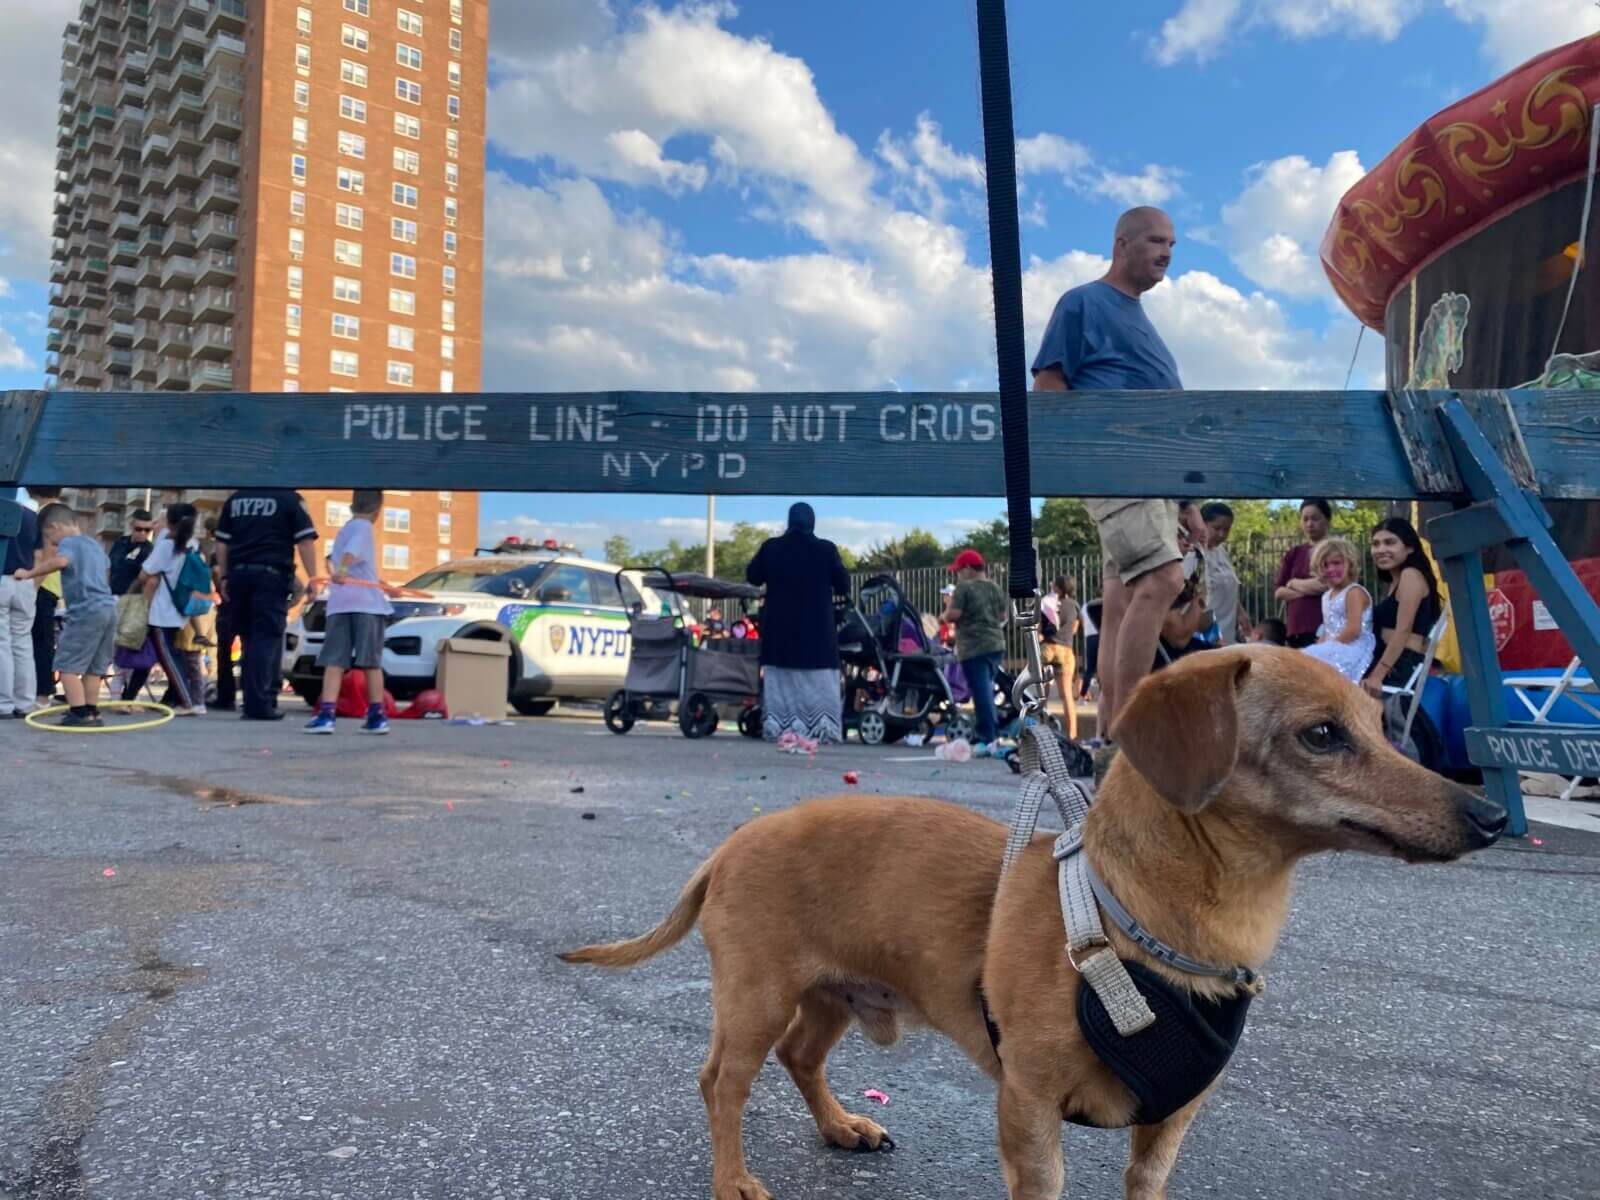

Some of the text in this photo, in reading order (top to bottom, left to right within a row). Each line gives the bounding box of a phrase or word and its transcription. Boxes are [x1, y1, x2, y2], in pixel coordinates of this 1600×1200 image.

[343, 404, 488, 440] POLICE
[529, 403, 618, 441] LINE
[696, 403, 748, 442] DO
[771, 405, 857, 442] NOT
[879, 403, 1003, 441] CROS
[230, 497, 277, 518] NYPD
[567, 625, 627, 656] NYPD
[1486, 735, 1559, 769] POLICE
